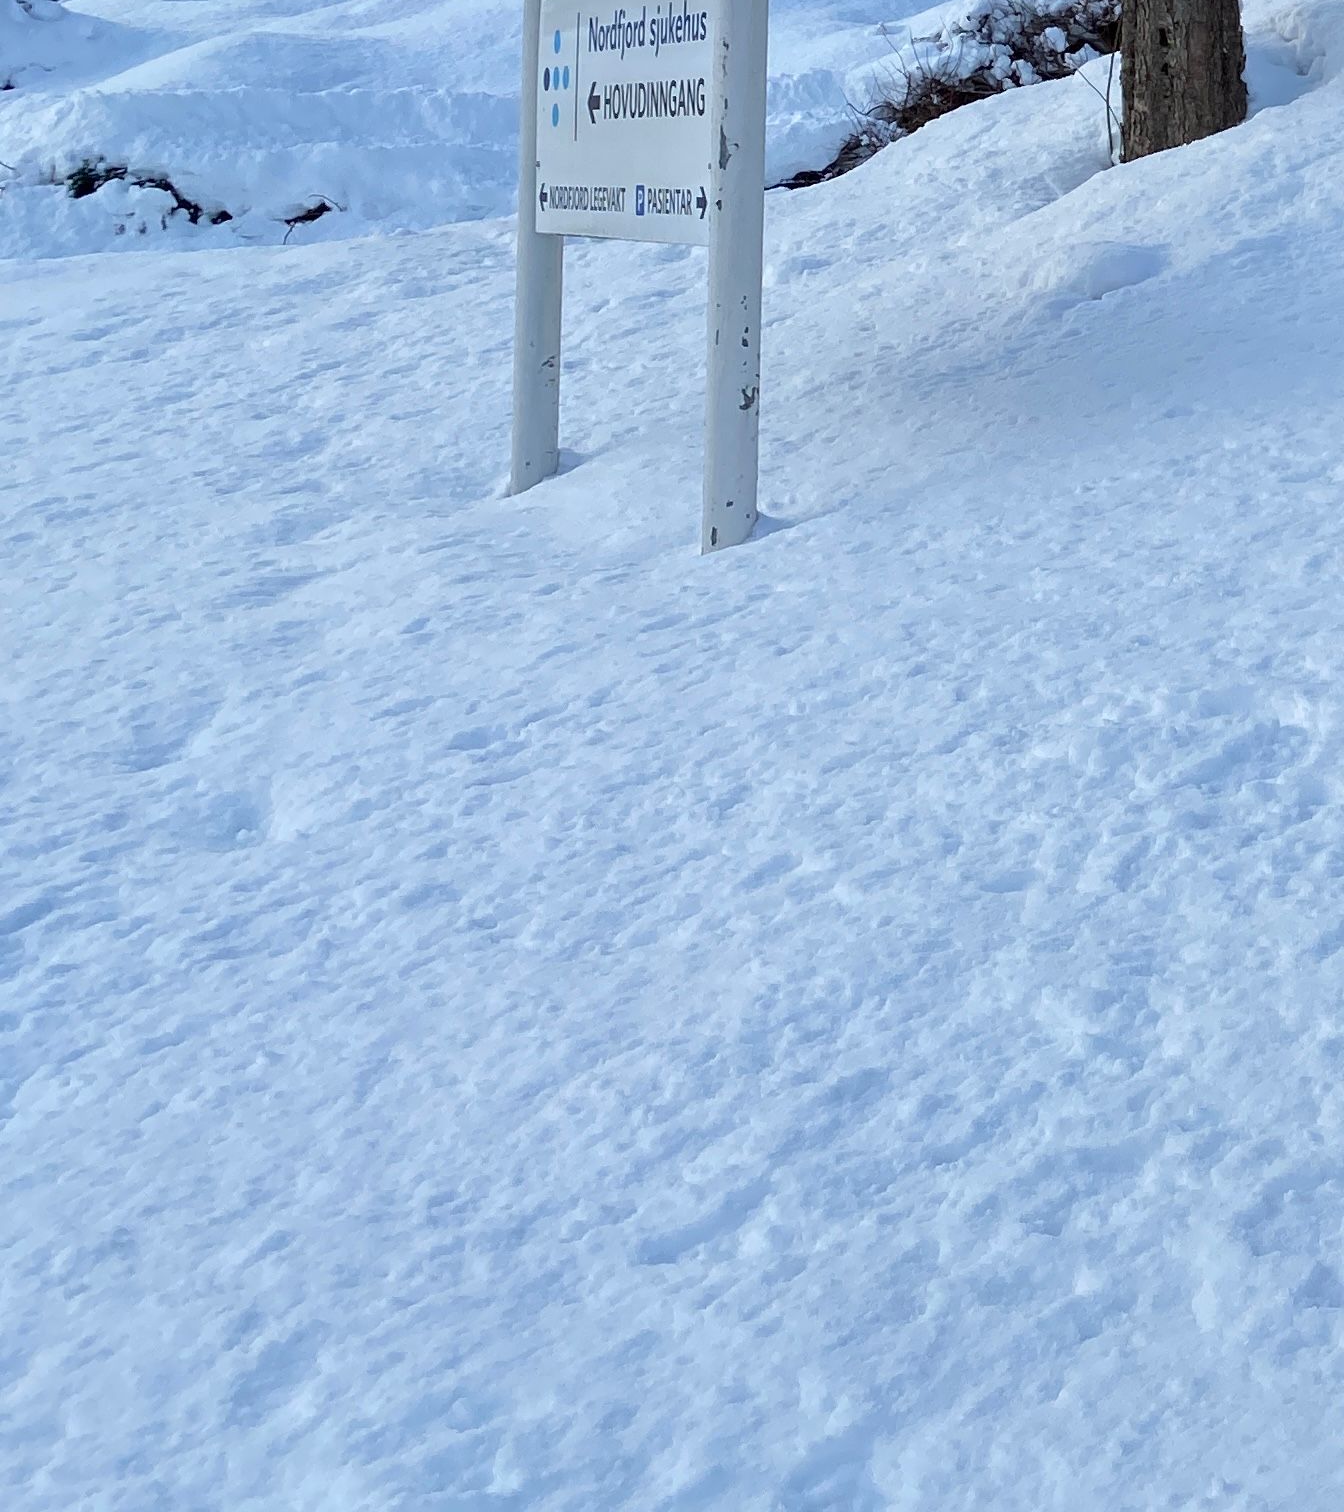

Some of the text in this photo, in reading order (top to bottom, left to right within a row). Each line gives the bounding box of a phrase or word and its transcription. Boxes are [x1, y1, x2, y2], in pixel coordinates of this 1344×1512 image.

[588, 0, 707, 60] Nordfjord sjukehus
[603, 77, 706, 120] HOVUDINNGANG
[549, 186, 626, 212] NORDFJORD LEGEVAKT
[648, 188, 693, 216] PASIENTAR
